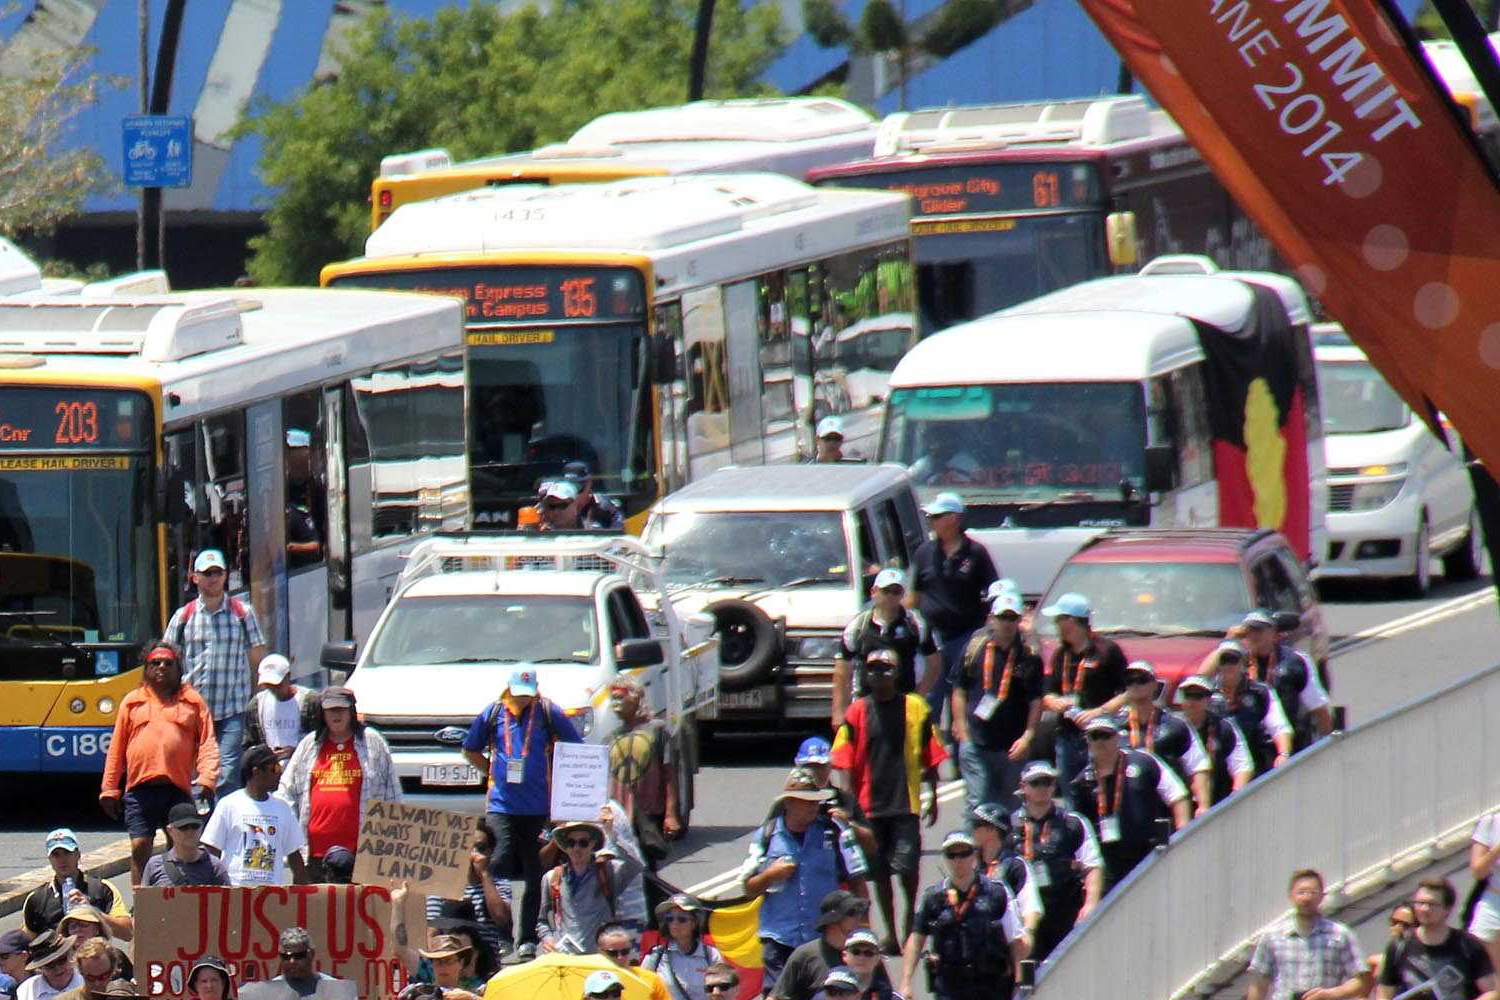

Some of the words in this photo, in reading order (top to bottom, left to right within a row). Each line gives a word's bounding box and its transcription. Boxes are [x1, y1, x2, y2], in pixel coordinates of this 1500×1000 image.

[1284, 0, 1422, 142] MMIT
[1253, 62, 1365, 186] 2014
[1033, 171, 1061, 207] 61
[475, 282, 549, 303] Express
[482, 302, 549, 319] Campus
[0, 424, 32, 441] Cnr
[55, 401, 99, 444] 203
[41, 459, 68, 468] HAIL
[72, 459, 116, 468] DRIVER
[368, 802, 443, 827] ALWAYS
[447, 815, 474, 831] WAS
[361, 820, 412, 841] ALWAYS
[420, 826, 447, 848] WILL
[449, 832, 472, 851] BE
[357, 838, 460, 868] ABORIGINAL
[377, 857, 434, 880] LAND
[326, 885, 393, 960] US
